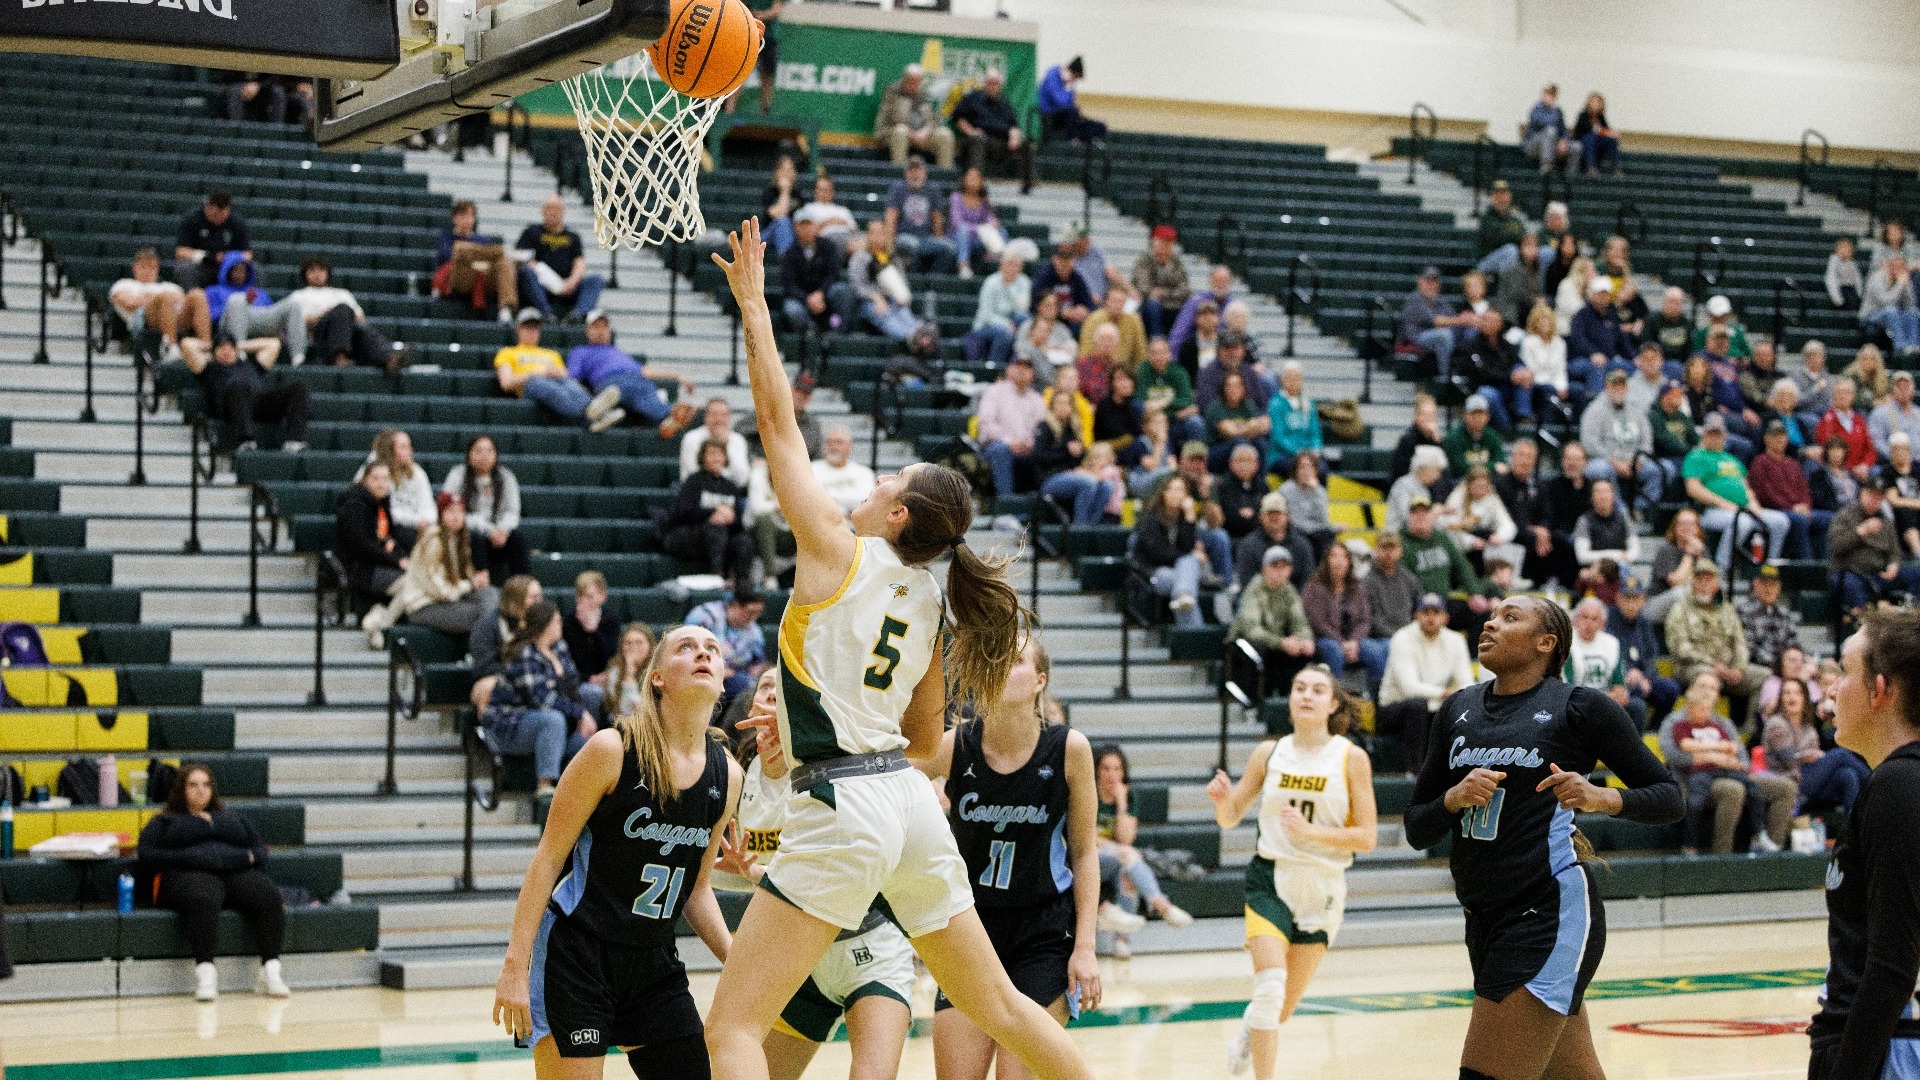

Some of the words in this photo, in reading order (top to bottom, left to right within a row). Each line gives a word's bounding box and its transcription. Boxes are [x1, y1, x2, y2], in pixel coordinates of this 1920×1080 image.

[673, 4, 716, 77] Wilson
[863, 612, 910, 692] 5
[1448, 735, 1544, 770] Cougars
[623, 806, 712, 856] Cougars
[958, 791, 1050, 834] Cougars
[1288, 798, 1315, 824] 0
[978, 840, 1016, 890] 11
[631, 863, 686, 919] 21
[570, 1028, 600, 1046] CCU
